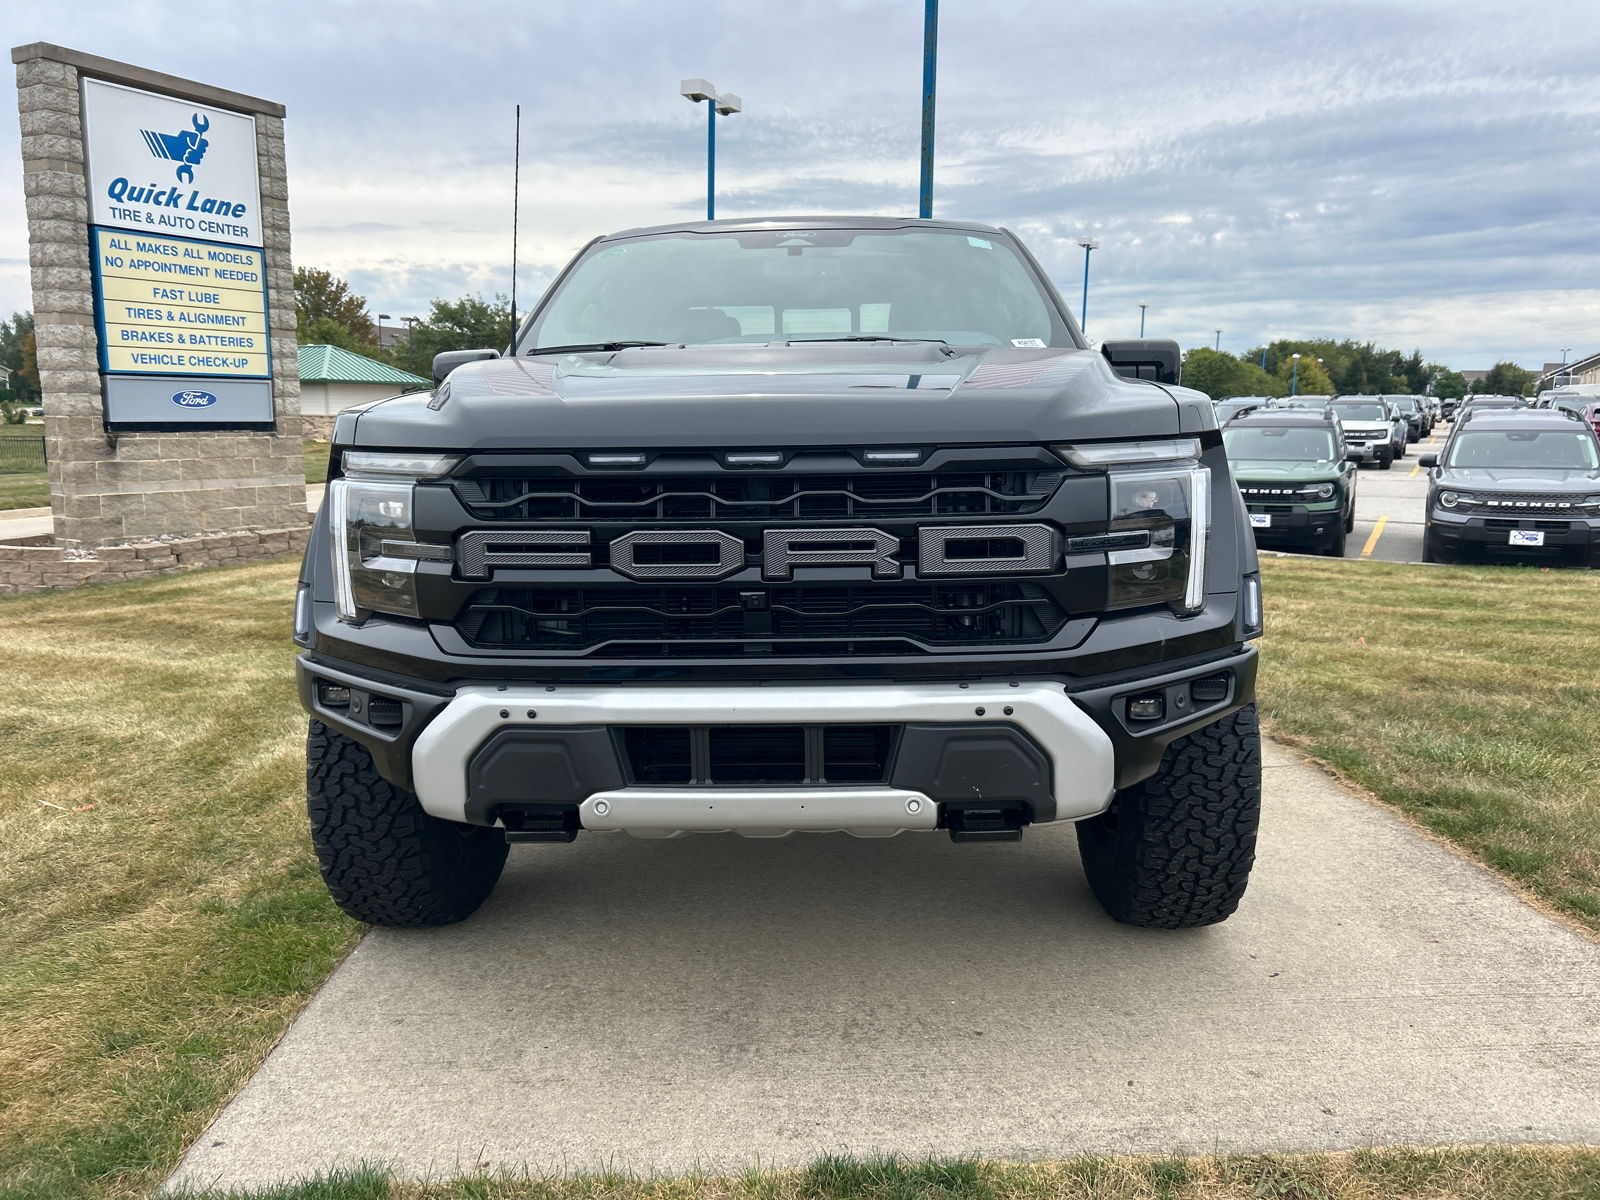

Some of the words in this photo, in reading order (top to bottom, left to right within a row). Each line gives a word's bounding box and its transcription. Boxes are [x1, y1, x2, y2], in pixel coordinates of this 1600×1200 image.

[108, 177, 184, 208] Quick
[186, 190, 246, 218] Lane
[109, 206, 142, 223] TIRE
[145, 212, 155, 225] &
[158, 214, 195, 230] AUTO
[199, 220, 249, 238] CENTER
[109, 238, 132, 251] ALL
[136, 241, 178, 257] MAKES
[183, 248, 204, 260] ALL
[208, 250, 253, 266] MODELS
[105, 256, 124, 268] NO
[129, 259, 210, 277] APPOINTMENT
[214, 268, 258, 283] NEEDED
[153, 287, 185, 301] FAST
[188, 291, 220, 304] LUBE
[125, 307, 163, 321] TIRES
[167, 311, 175, 321] &
[178, 311, 247, 327] ALIGNMENT
[121, 330, 174, 343] BRAKES
[177, 334, 186, 344] &
[189, 334, 254, 348] BATTERIES
[131, 353, 186, 366] VEHICLE
[188, 355, 249, 369] CHECK-UP
[180, 391, 209, 406] Ford
[1487, 500, 1571, 508] BRONCO
[460, 523, 1056, 578] FORD
